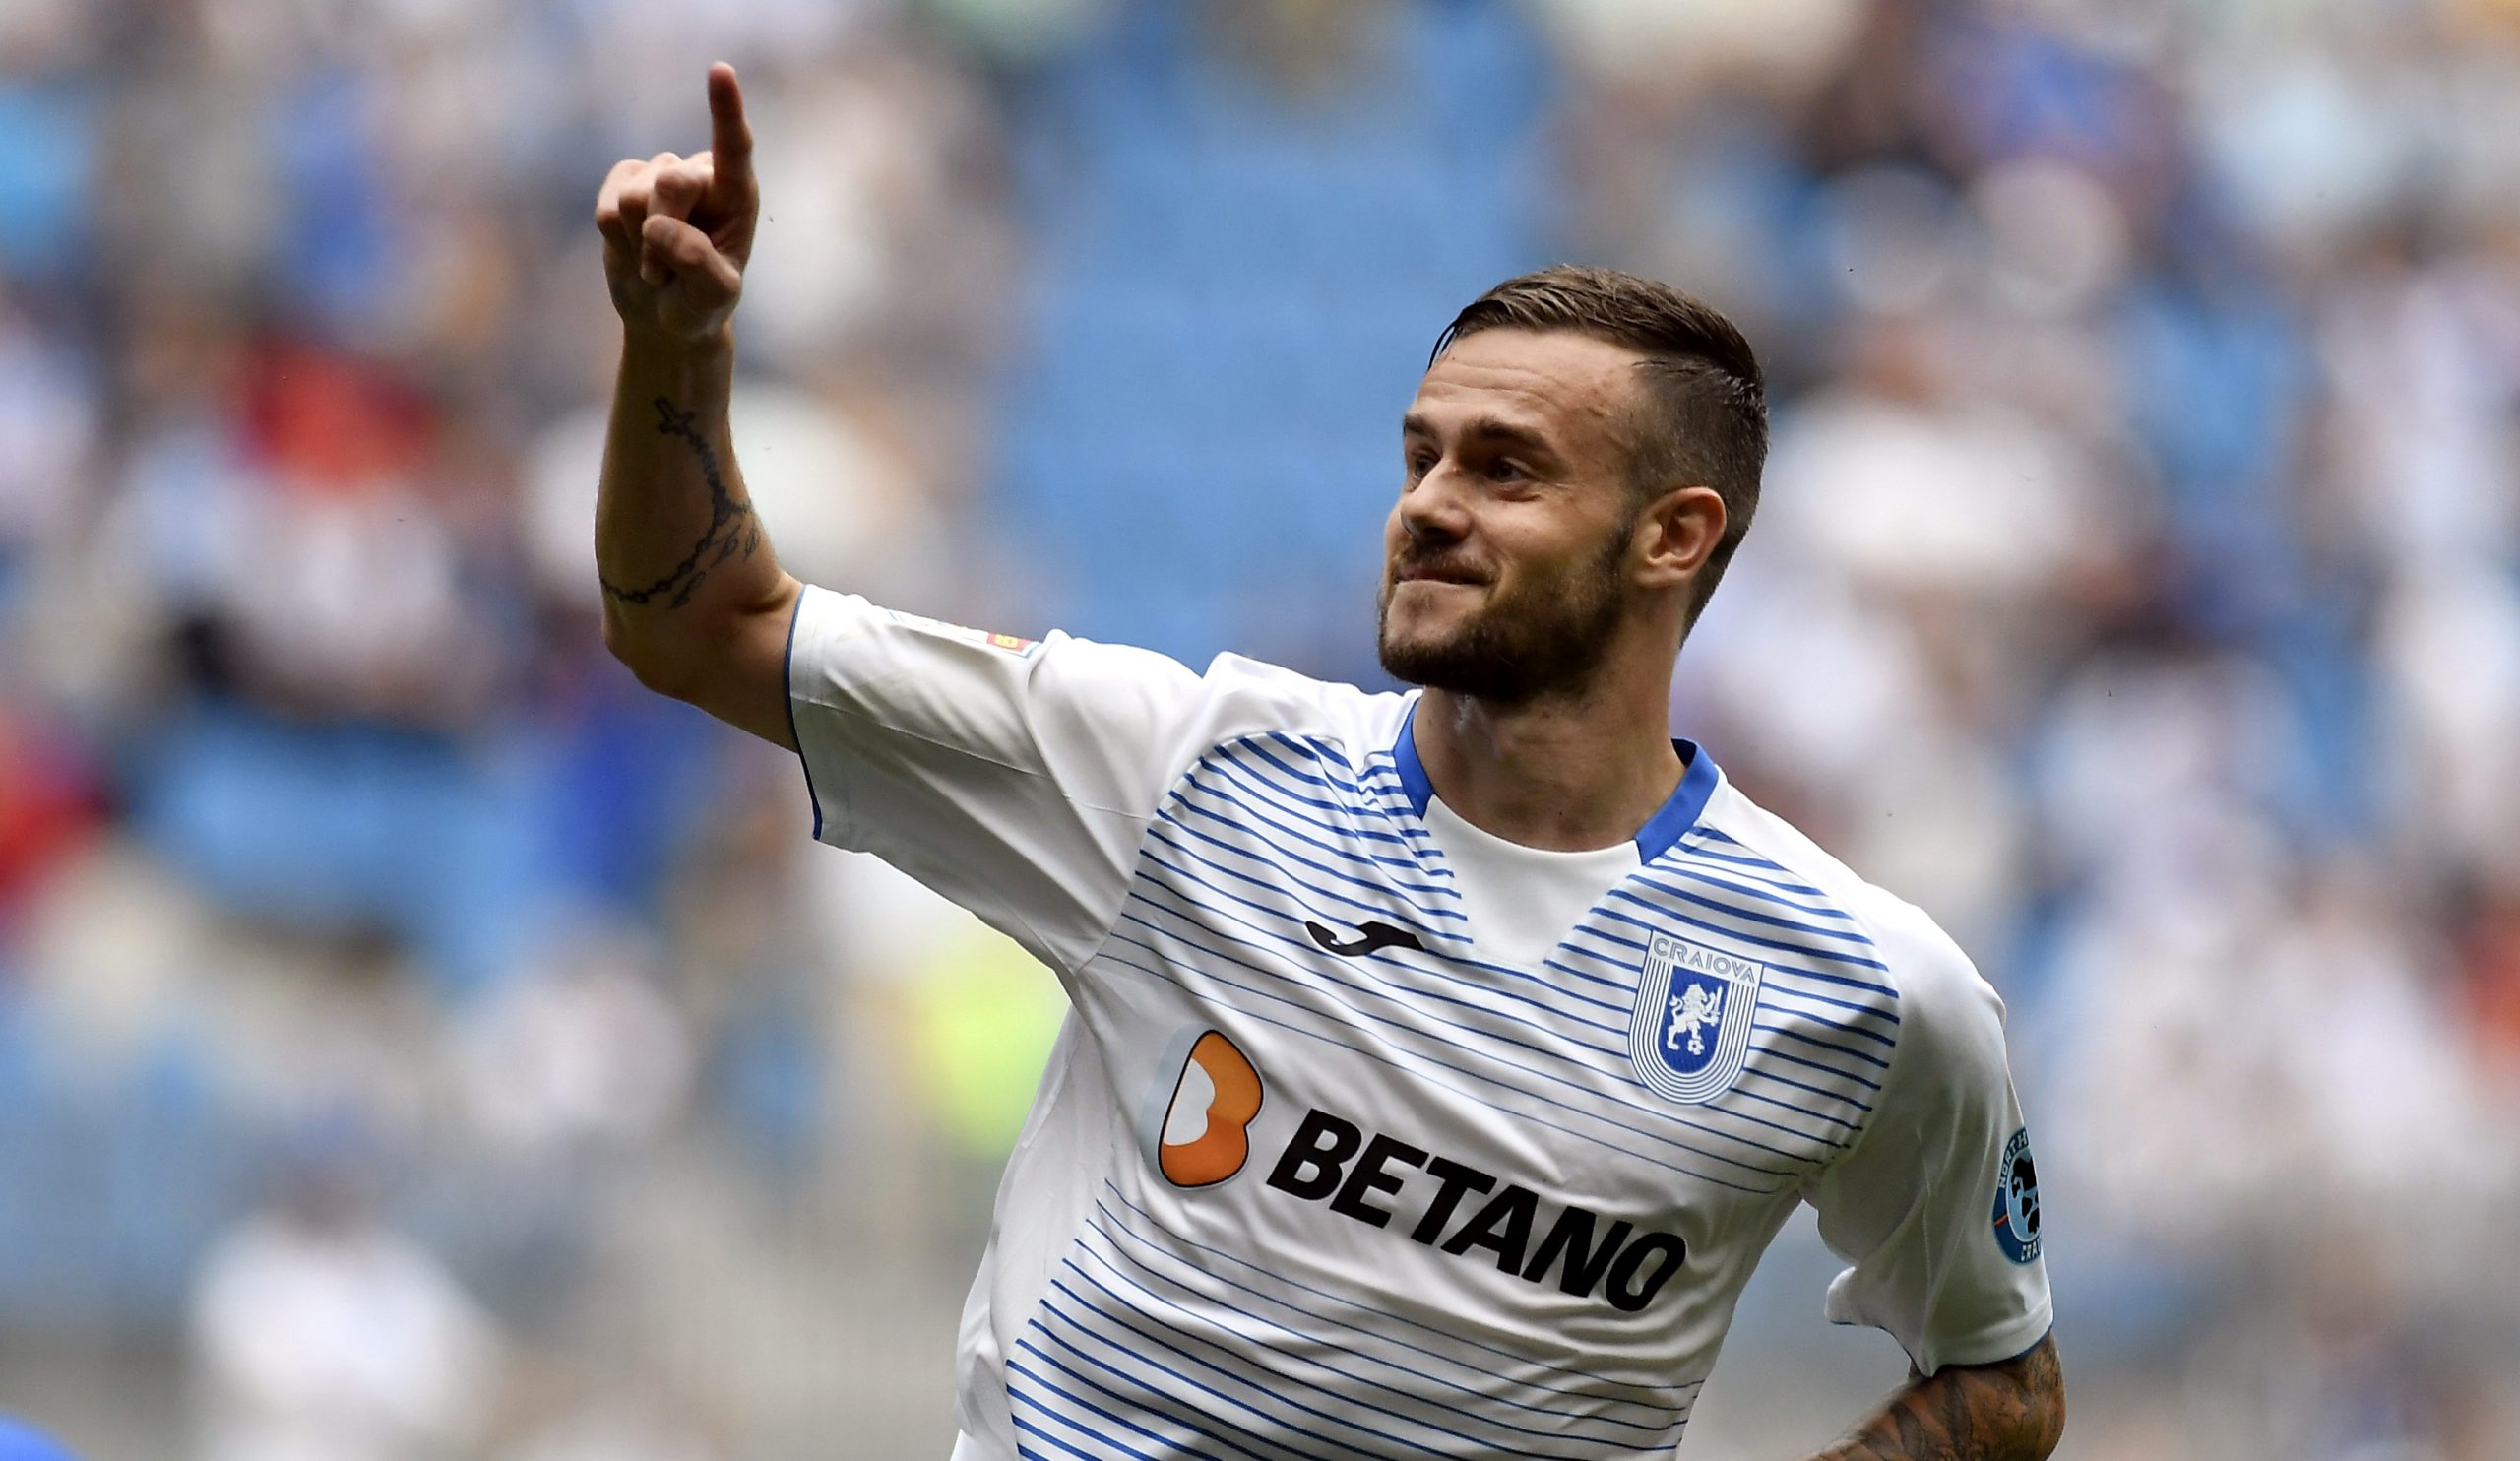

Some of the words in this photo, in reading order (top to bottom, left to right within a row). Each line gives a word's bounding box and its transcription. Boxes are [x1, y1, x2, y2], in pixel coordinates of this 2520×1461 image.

[1654, 938, 1755, 984] CRAIOVA
[1998, 1131, 2028, 1189] NORTH
[1266, 1108, 1686, 1311] BETANO
